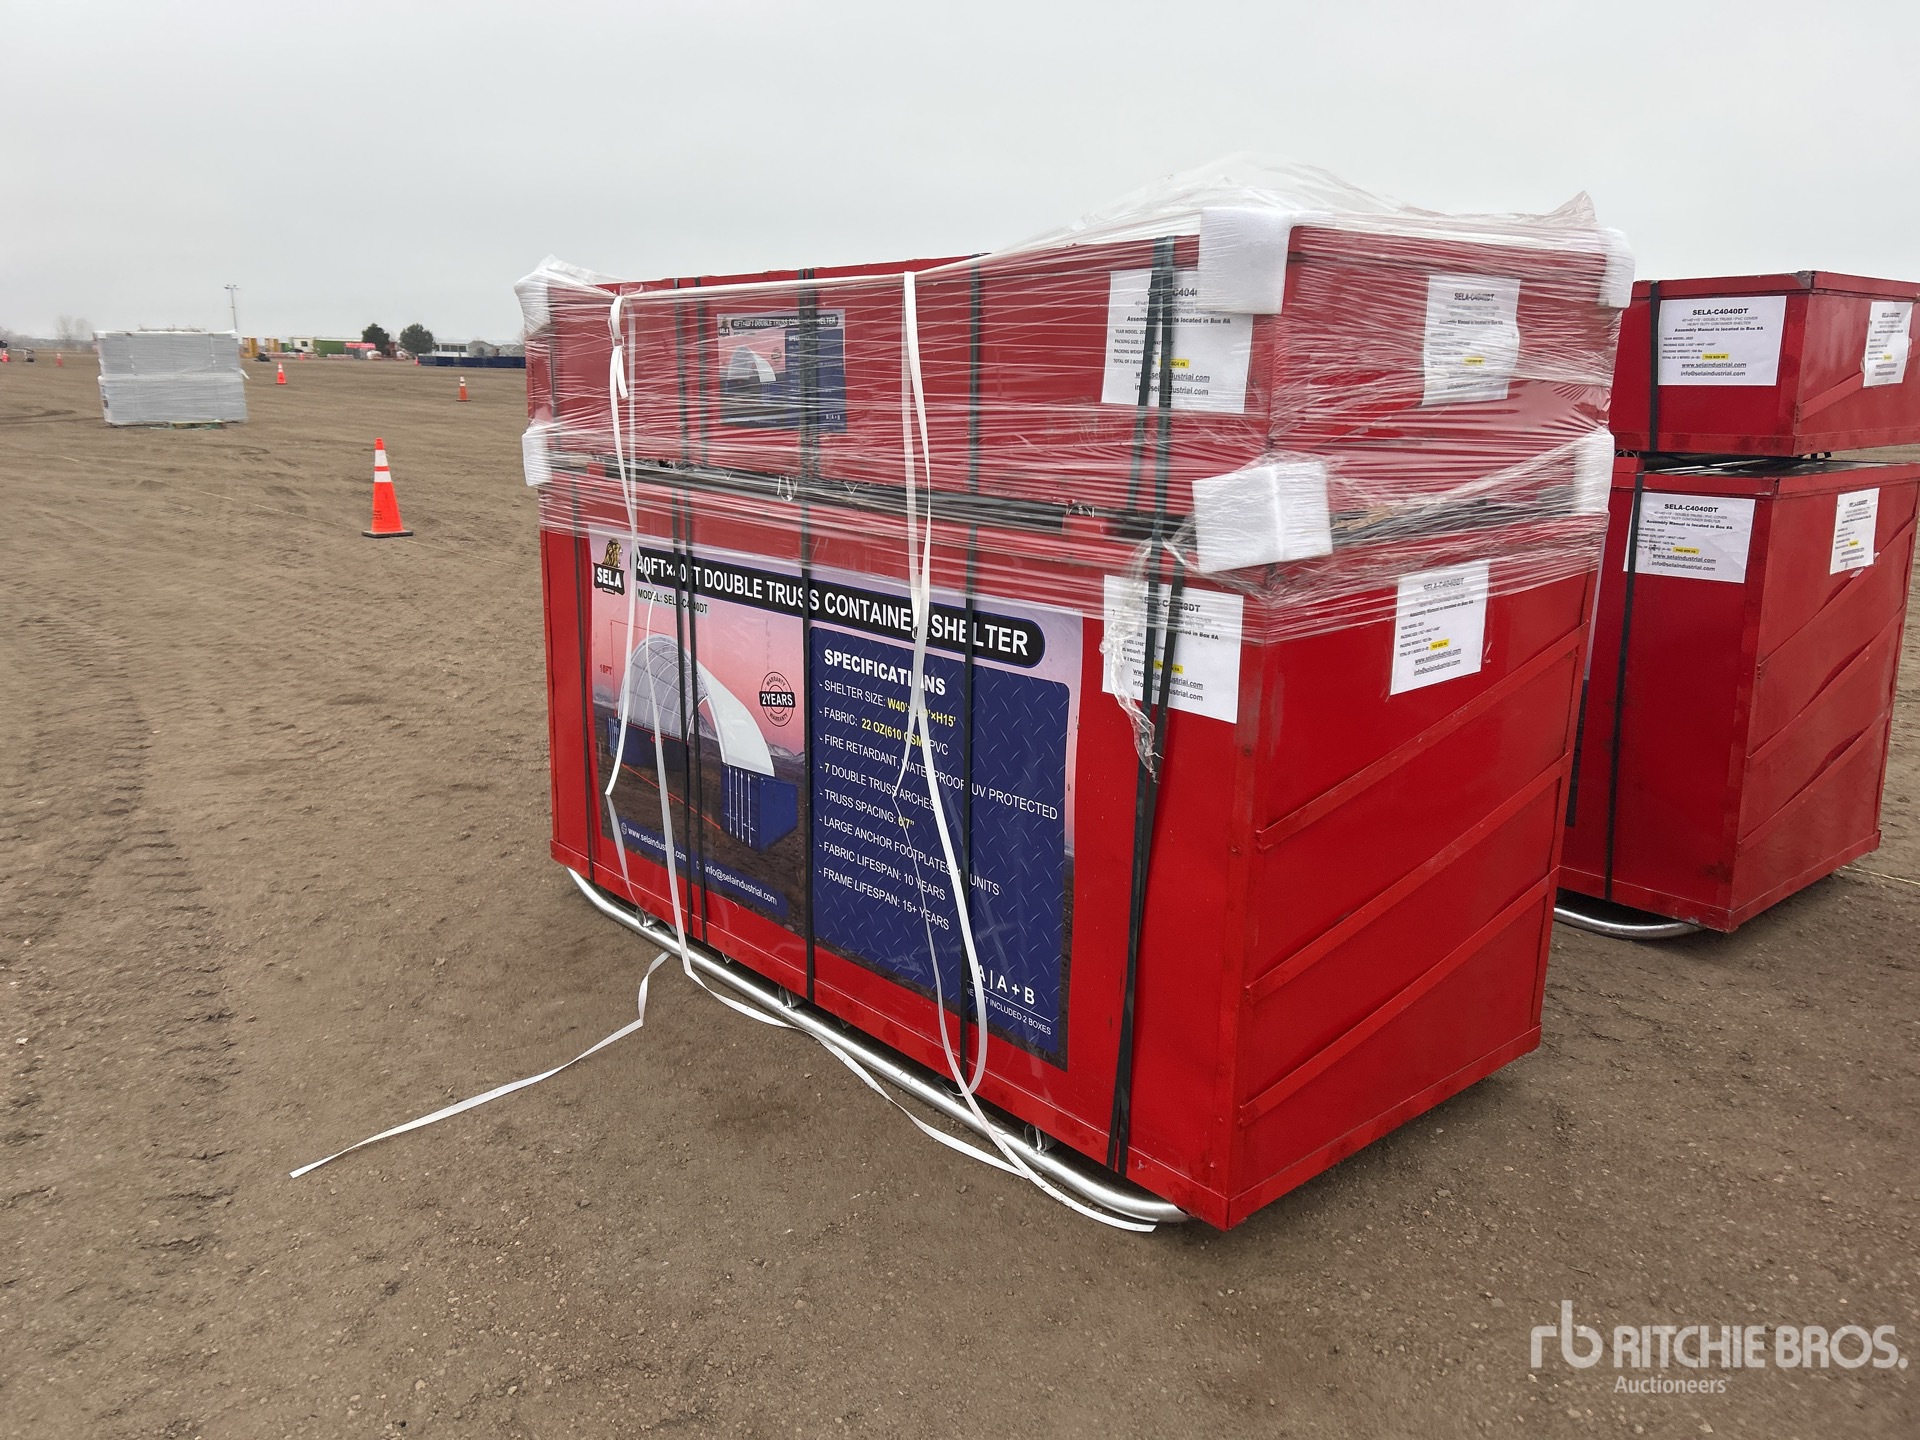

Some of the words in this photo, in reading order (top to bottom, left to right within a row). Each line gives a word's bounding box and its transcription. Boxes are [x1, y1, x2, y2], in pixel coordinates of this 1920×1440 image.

[1664, 504, 1718, 513] SELA-C4040DT
[597, 567, 622, 589] SELA
[705, 569, 762, 599] DOUBLE
[765, 580, 820, 611] TRUSS
[824, 592, 922, 634] CONTAINE
[931, 614, 1029, 657] SHELTER
[824, 649, 946, 696] SPECIFICATINS
[761, 693, 793, 706] 2YEARS
[824, 680, 863, 700] SHELTER
[864, 690, 886, 708] SIZE:
[824, 708, 858, 727] FABRIC:
[861, 718, 872, 730] 22
[929, 739, 949, 756] PVC
[824, 734, 844, 749] FIRE
[846, 742, 900, 770] RETARDANT,
[902, 758, 965, 791] WATEPROOF
[971, 784, 986, 798] UV
[988, 788, 1058, 821] PROTECTED
[824, 762, 830, 773] 7
[832, 764, 867, 786] DOUBLE
[869, 776, 897, 797] TRUSS
[899, 790, 936, 812] ARCHES
[825, 789, 853, 809] TRUSS
[855, 801, 897, 825] SPACING:
[627, 827, 687, 862] www.selaindus.com
[824, 815, 853, 835] LARGE
[855, 827, 892, 850] ANCHOR
[970, 873, 1000, 896] UNITS
[705, 864, 778, 906] info@selaindustrial.com
[824, 841, 855, 862] FABRIC
[857, 853, 902, 881] LIFESPAN:
[904, 873, 914, 886] 10
[916, 876, 946, 901] YEARS
[823, 868, 853, 889] FRAME
[854, 881, 900, 908] LIFESPAN:
[903, 899, 917, 914] 15+
[919, 906, 950, 930] YEARS
[997, 975, 1008, 993] A
[1024, 986, 1035, 1005] B
[989, 999, 1021, 1021] INCLUDED
[1022, 1015, 1027, 1024] 2
[1028, 1017, 1051, 1036] BOXES
